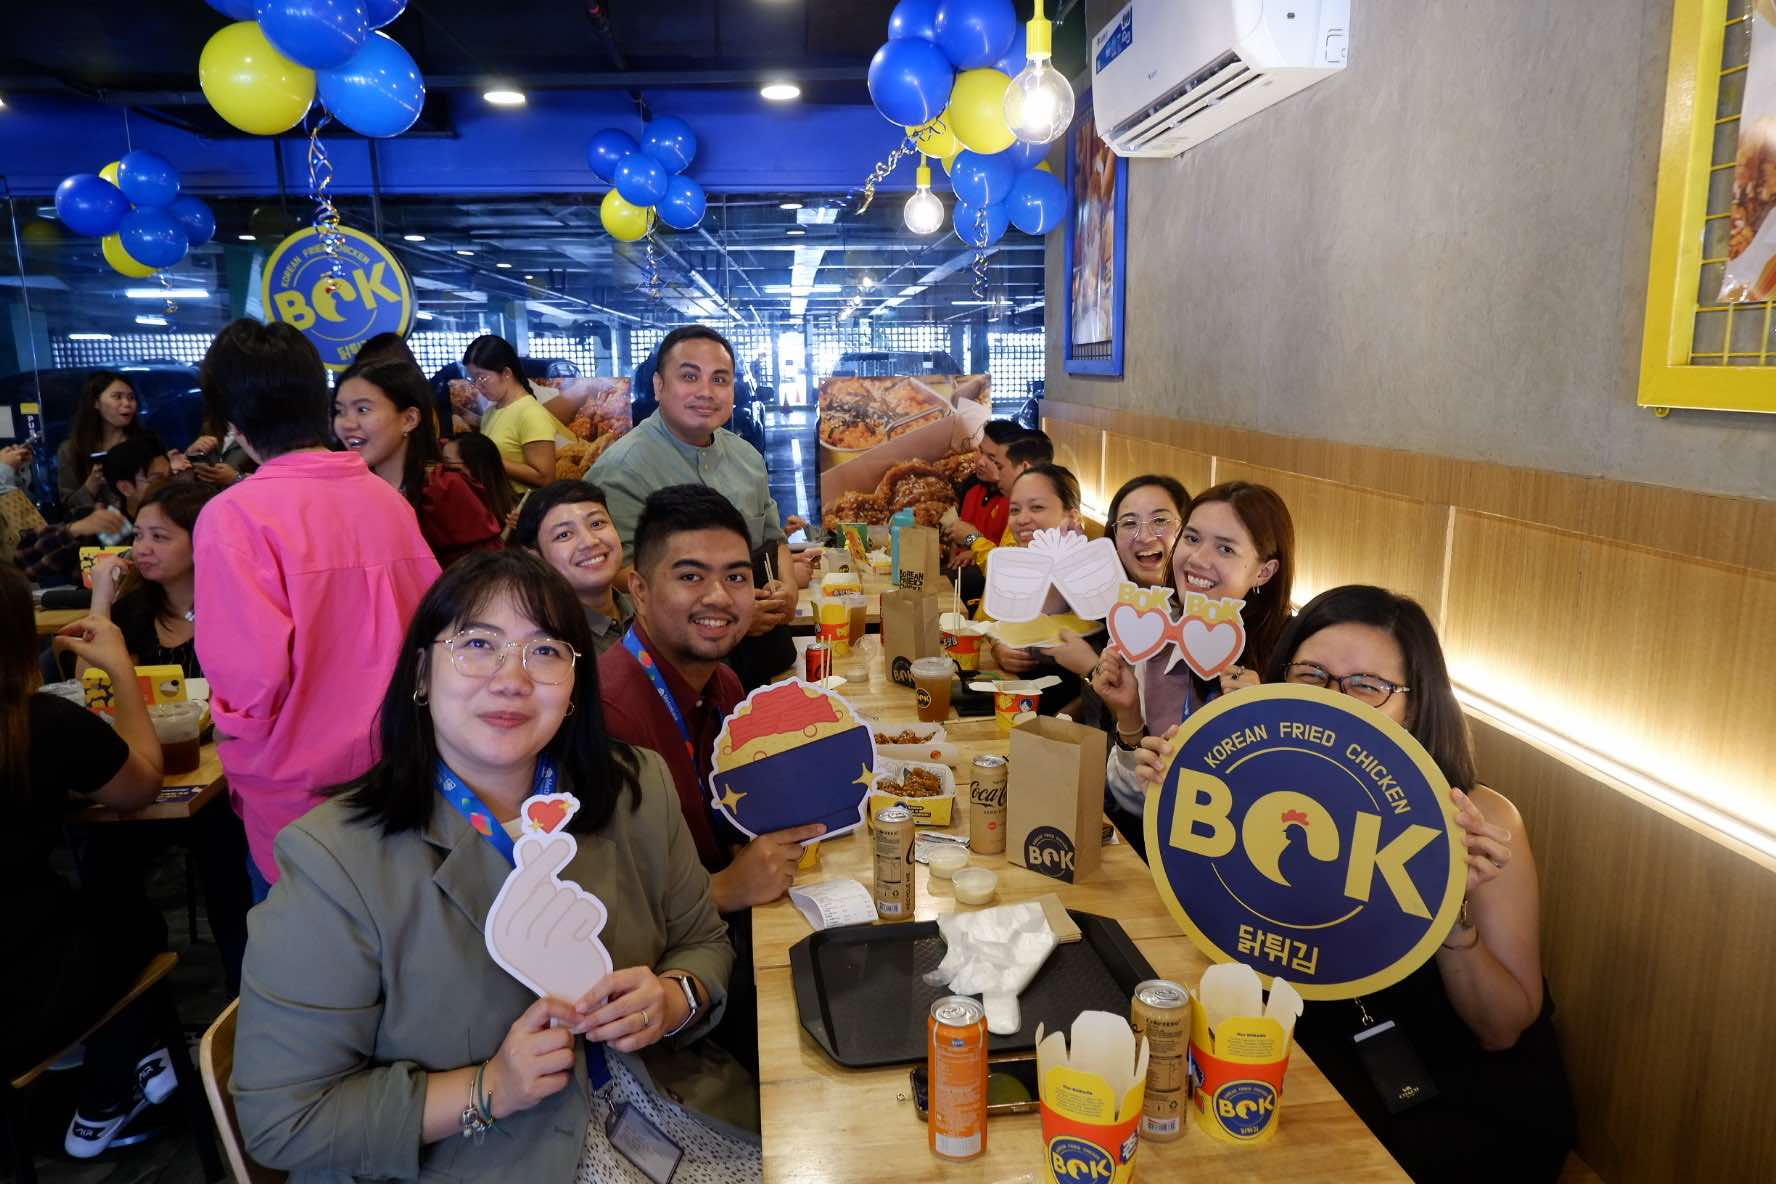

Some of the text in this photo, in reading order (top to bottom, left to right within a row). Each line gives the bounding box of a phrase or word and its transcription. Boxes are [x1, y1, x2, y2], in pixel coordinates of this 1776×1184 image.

[273, 261, 401, 331] BOK
[1119, 582, 1174, 611] BOK
[1186, 592, 1246, 624] BOK
[1203, 721, 1411, 816] KOREAN FRIED CHICKEN
[1028, 845, 1075, 871] BOK
[1168, 766, 1443, 921] BOK
[1236, 923, 1320, 976] 닭튀김
[1218, 1094, 1274, 1120] BOK
[75, 1127, 95, 1137] AIR
[1051, 1150, 1111, 1181] BOK
